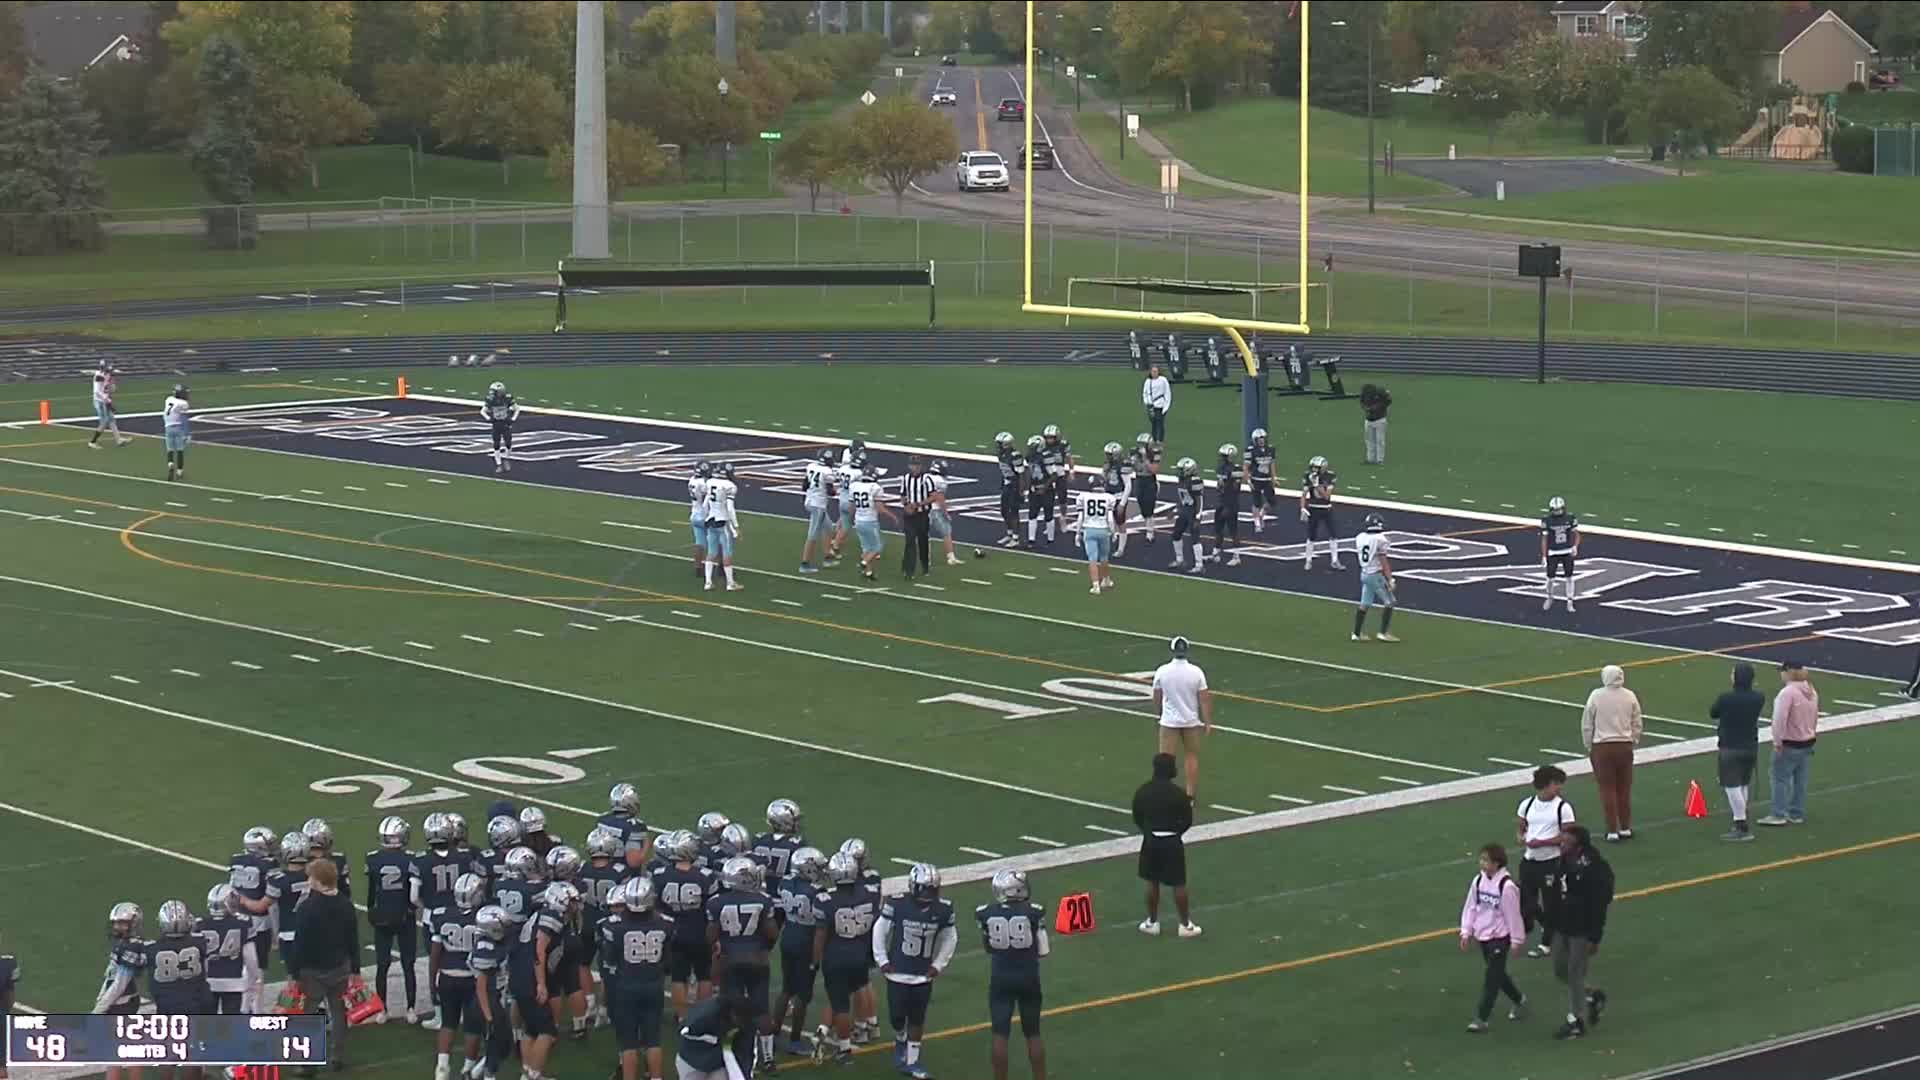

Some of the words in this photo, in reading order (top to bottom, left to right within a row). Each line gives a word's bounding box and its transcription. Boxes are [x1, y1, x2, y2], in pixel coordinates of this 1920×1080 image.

[710, 486, 718, 502] 5
[852, 491, 869, 509] 62
[1087, 499, 1106, 517] 85
[1361, 545, 1370, 562] 6
[309, 756, 587, 809] 20
[379, 865, 403, 890] 2
[432, 864, 459, 891] 11
[719, 904, 763, 936] 47
[1067, 896, 1092, 929] 20
[902, 926, 936, 958] 51
[986, 916, 1034, 950] 99
[154, 946, 202, 984] 83
